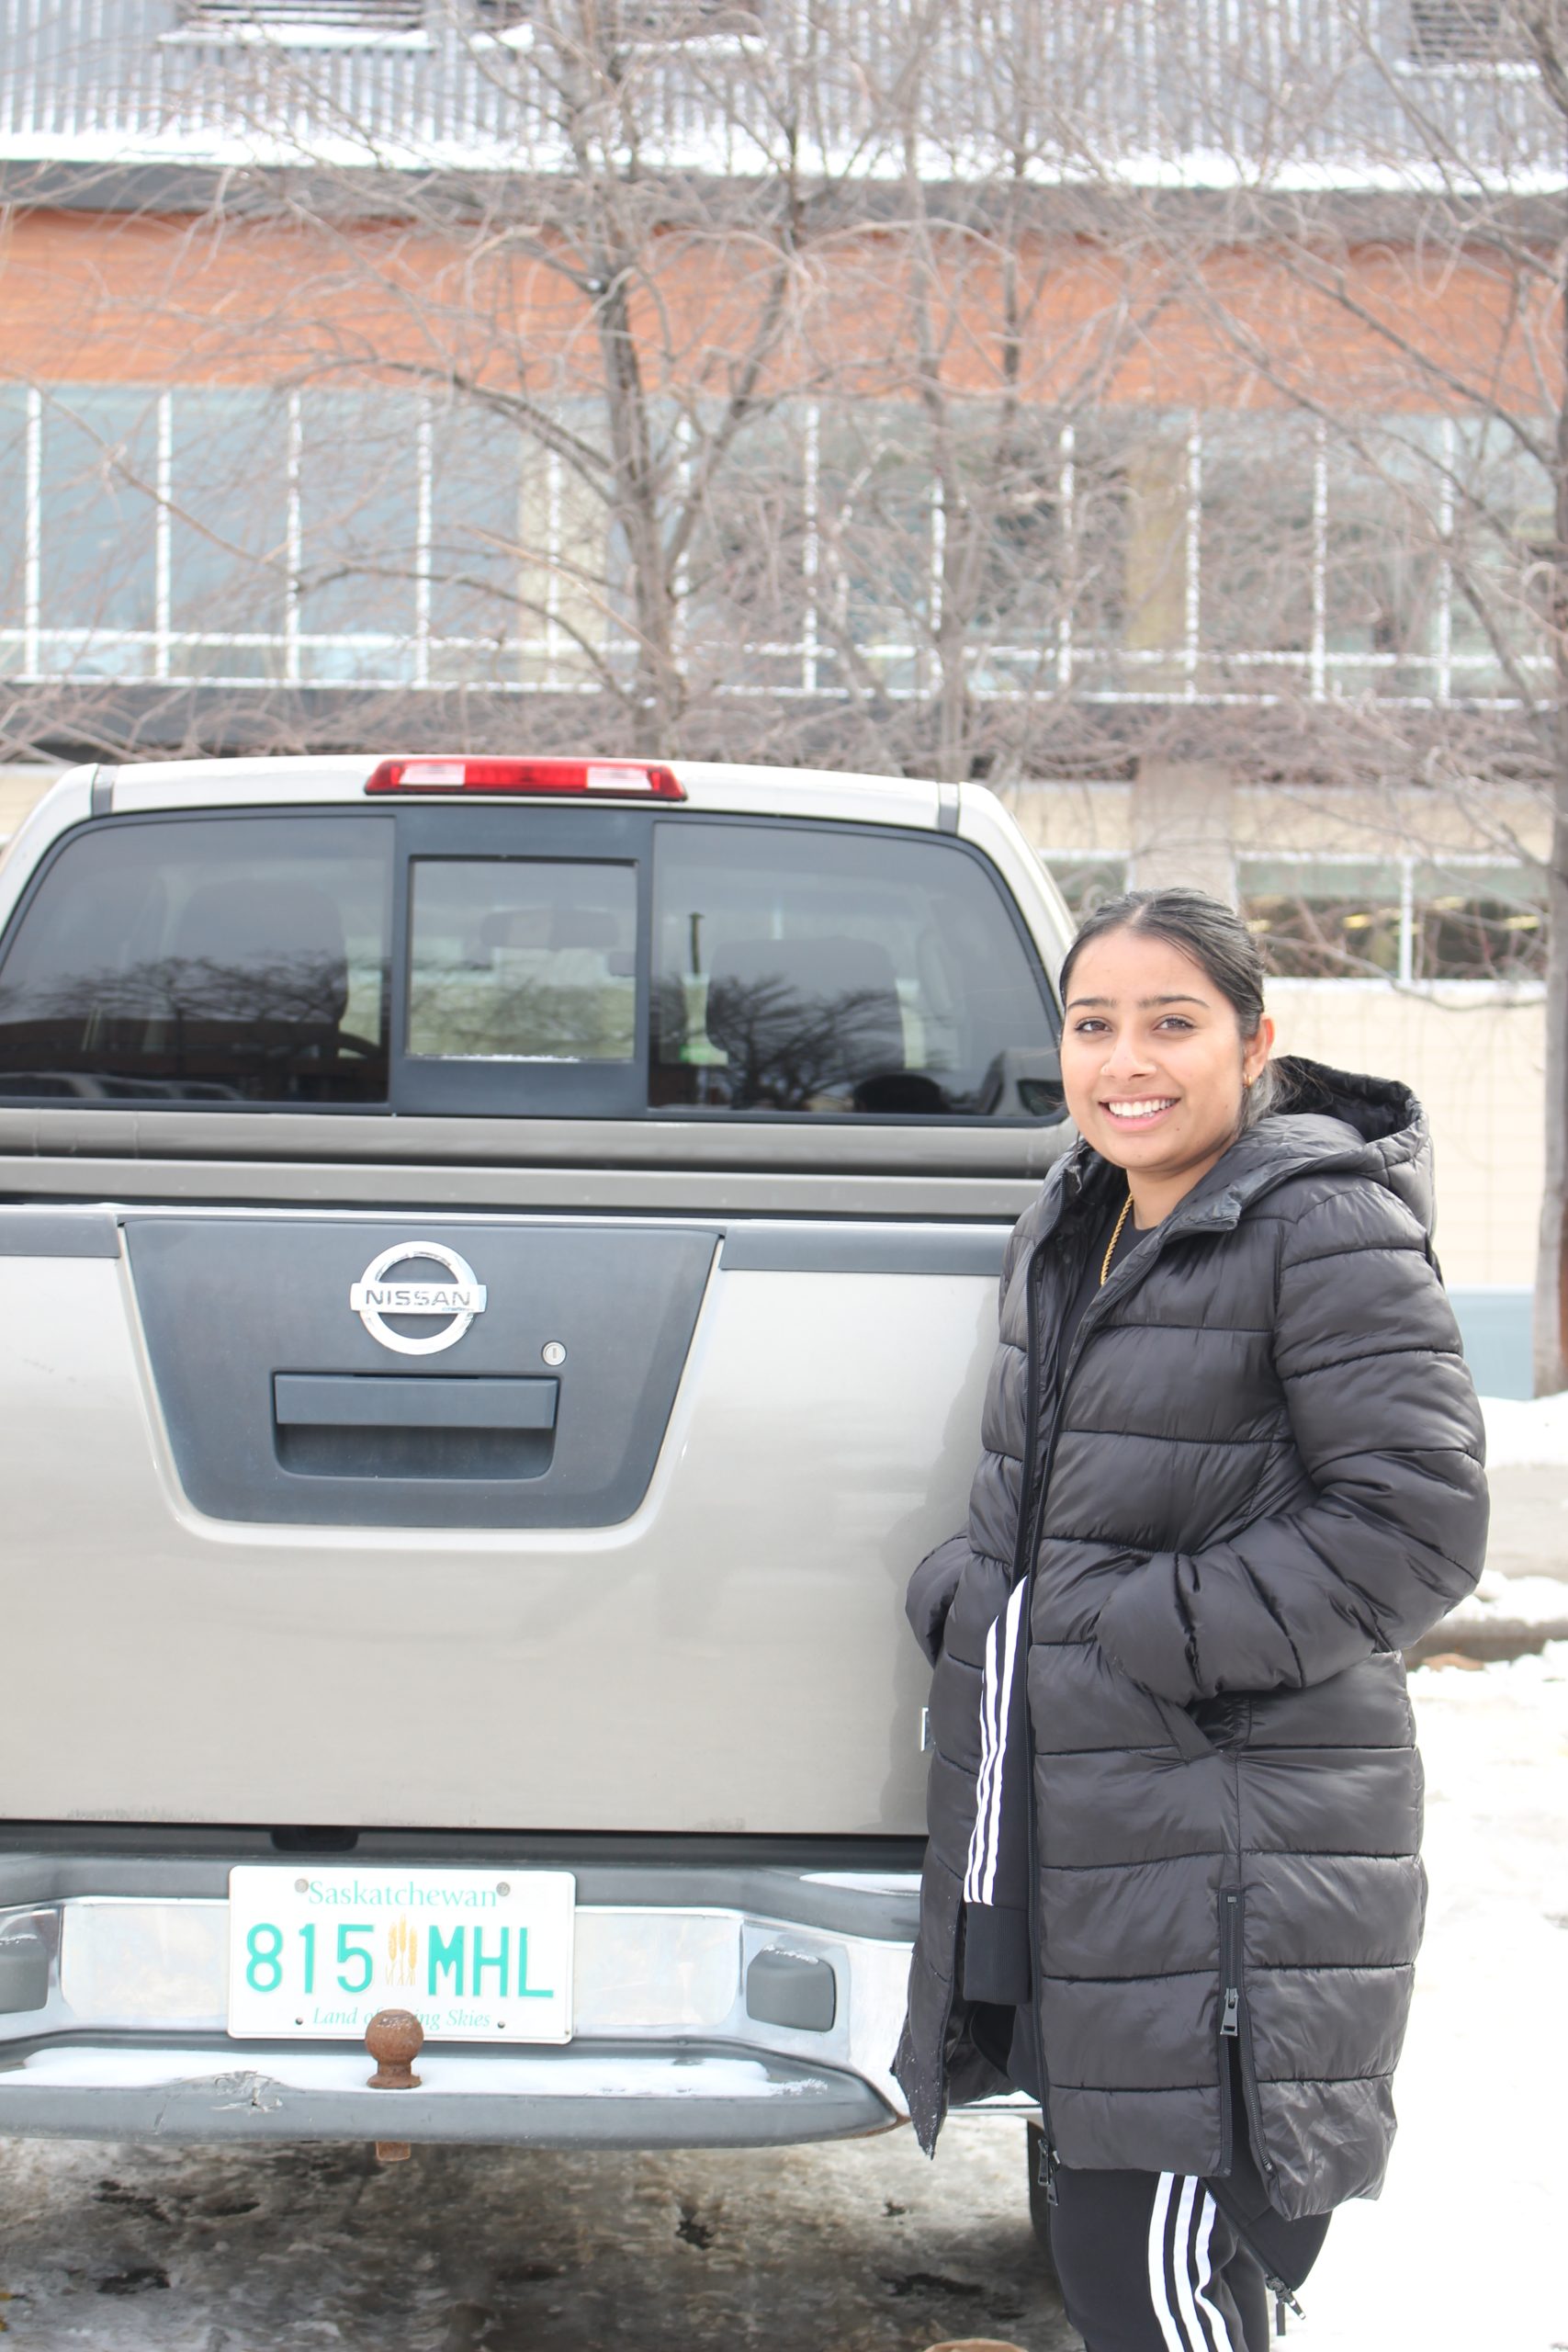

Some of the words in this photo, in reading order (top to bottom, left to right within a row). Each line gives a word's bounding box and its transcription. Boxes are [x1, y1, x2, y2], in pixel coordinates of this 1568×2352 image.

[366, 1289, 470, 1306] NISSAN
[308, 1881, 497, 1907] Saskatchewan
[246, 1923, 375, 1994] 815
[428, 1925, 555, 1997] MHL
[313, 2007, 357, 2025] Land
[446, 2009, 491, 2029] Skies
